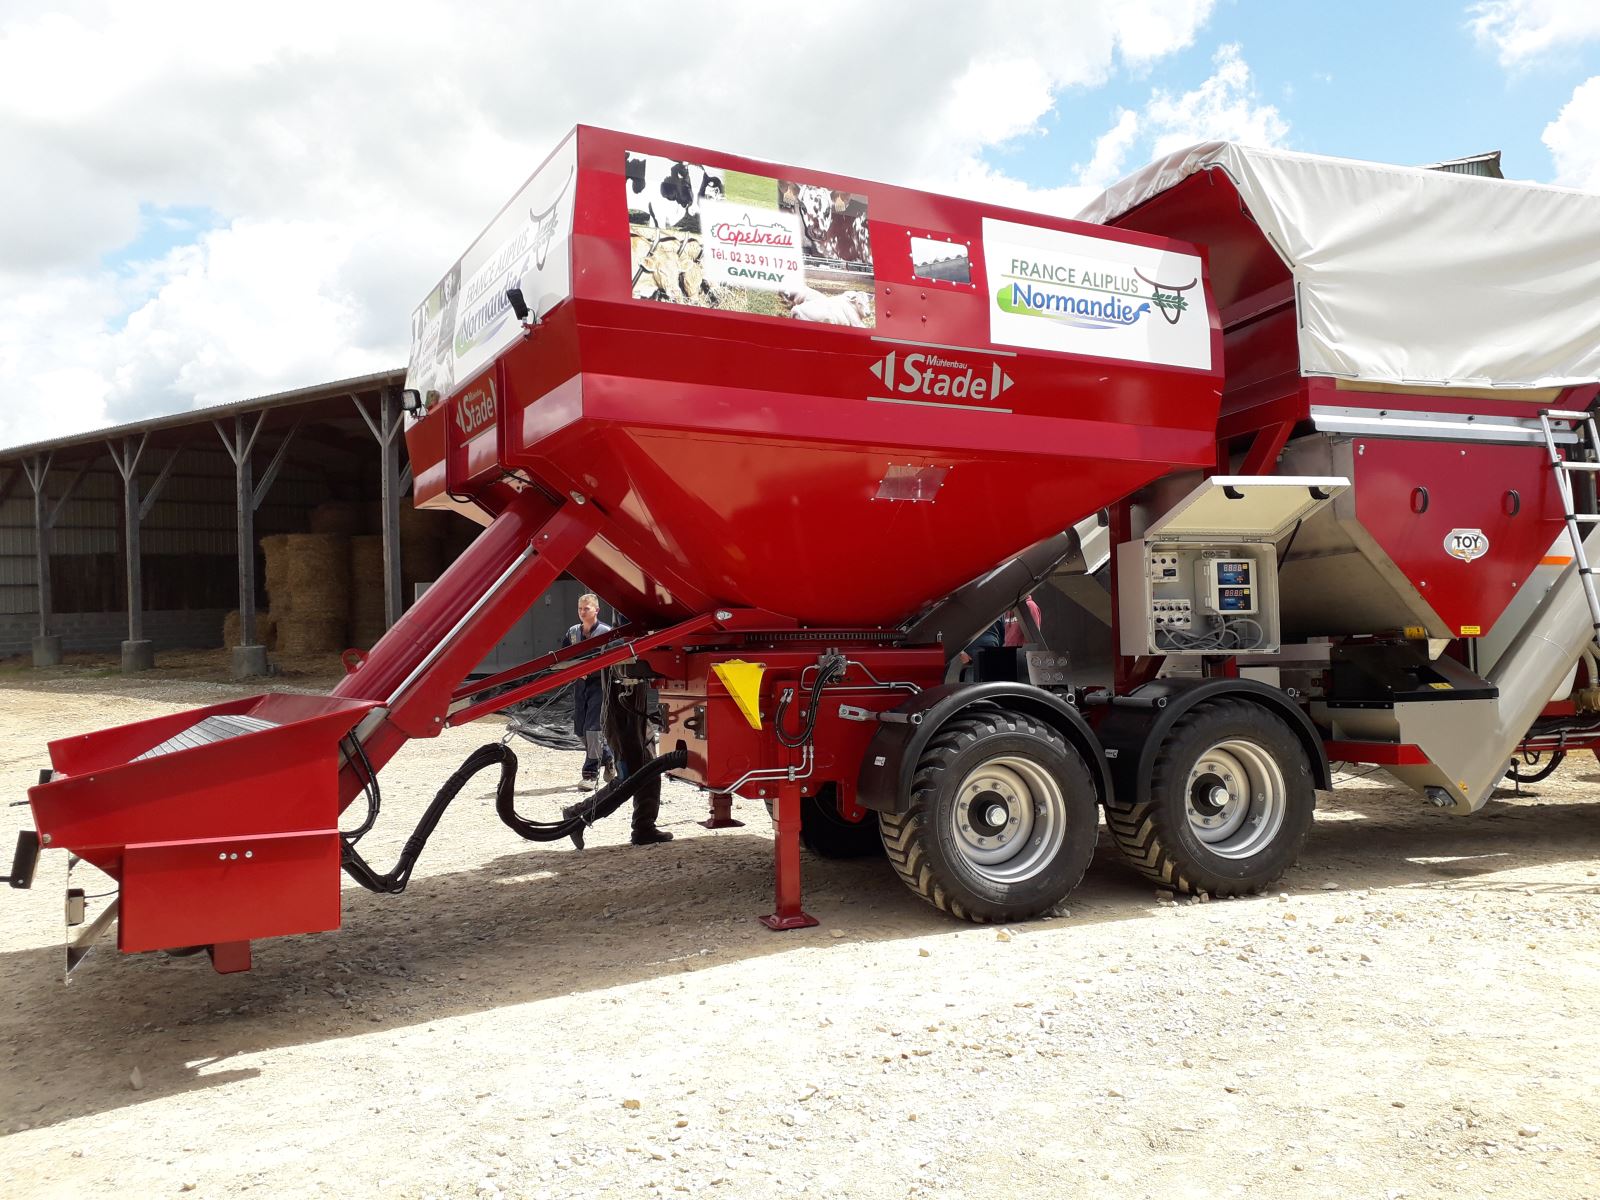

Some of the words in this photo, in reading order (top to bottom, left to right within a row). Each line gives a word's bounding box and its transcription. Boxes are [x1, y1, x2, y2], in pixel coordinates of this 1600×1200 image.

[717, 223, 792, 246] Copelveau
[711, 248, 728, 261] Tél.
[730, 251, 742, 263] 02
[745, 253, 756, 265] 33
[759, 255, 769, 267] 91
[774, 257, 783, 269] 17
[787, 259, 798, 271] 20
[727, 266, 785, 283] GAVRAY
[1011, 258, 1076, 284] FRANCE
[1081, 271, 1139, 294] ALIPLUS
[1013, 281, 1134, 322] Normandie
[898, 352, 987, 400] Stade
[463, 391, 494, 433] Stade
[1454, 536, 1479, 548] TOY
